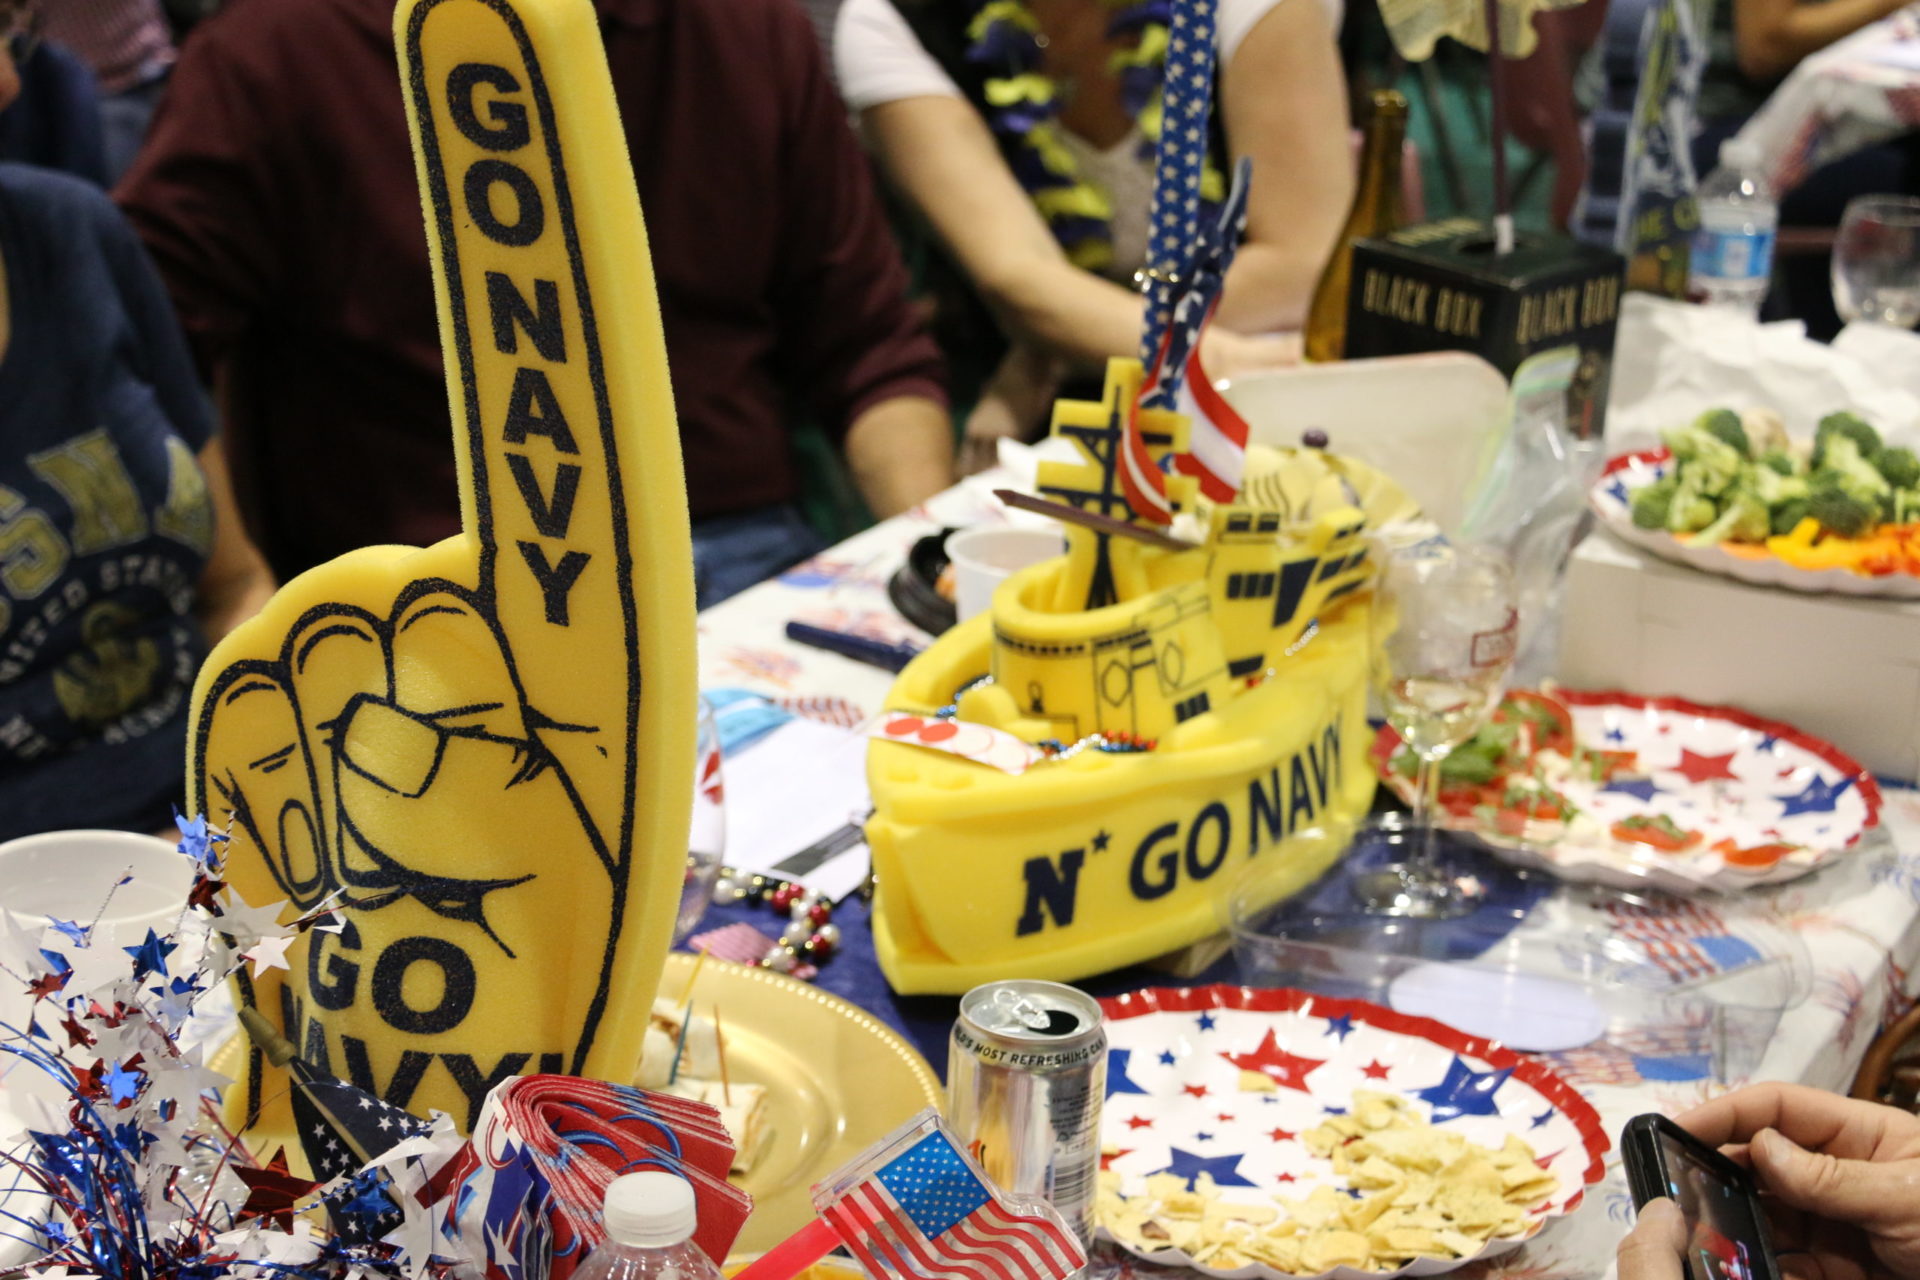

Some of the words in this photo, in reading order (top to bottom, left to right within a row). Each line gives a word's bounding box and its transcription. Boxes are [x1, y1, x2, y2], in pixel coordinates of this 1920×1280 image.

[446, 62, 545, 247] GO
[1363, 268, 1430, 326] BLACK
[1434, 286, 1483, 338] BOX
[1516, 286, 1577, 345] BLACK
[485, 271, 591, 627] NAVY
[1016, 848, 1085, 937] N
[1129, 801, 1231, 901] GO
[1249, 712, 1342, 857] NAVY
[307, 915, 477, 1035] GO
[280, 982, 563, 1133] NAVY
[973, 1043, 1007, 1061] MOST
[1009, 1048, 1088, 1067] REFRESHING
